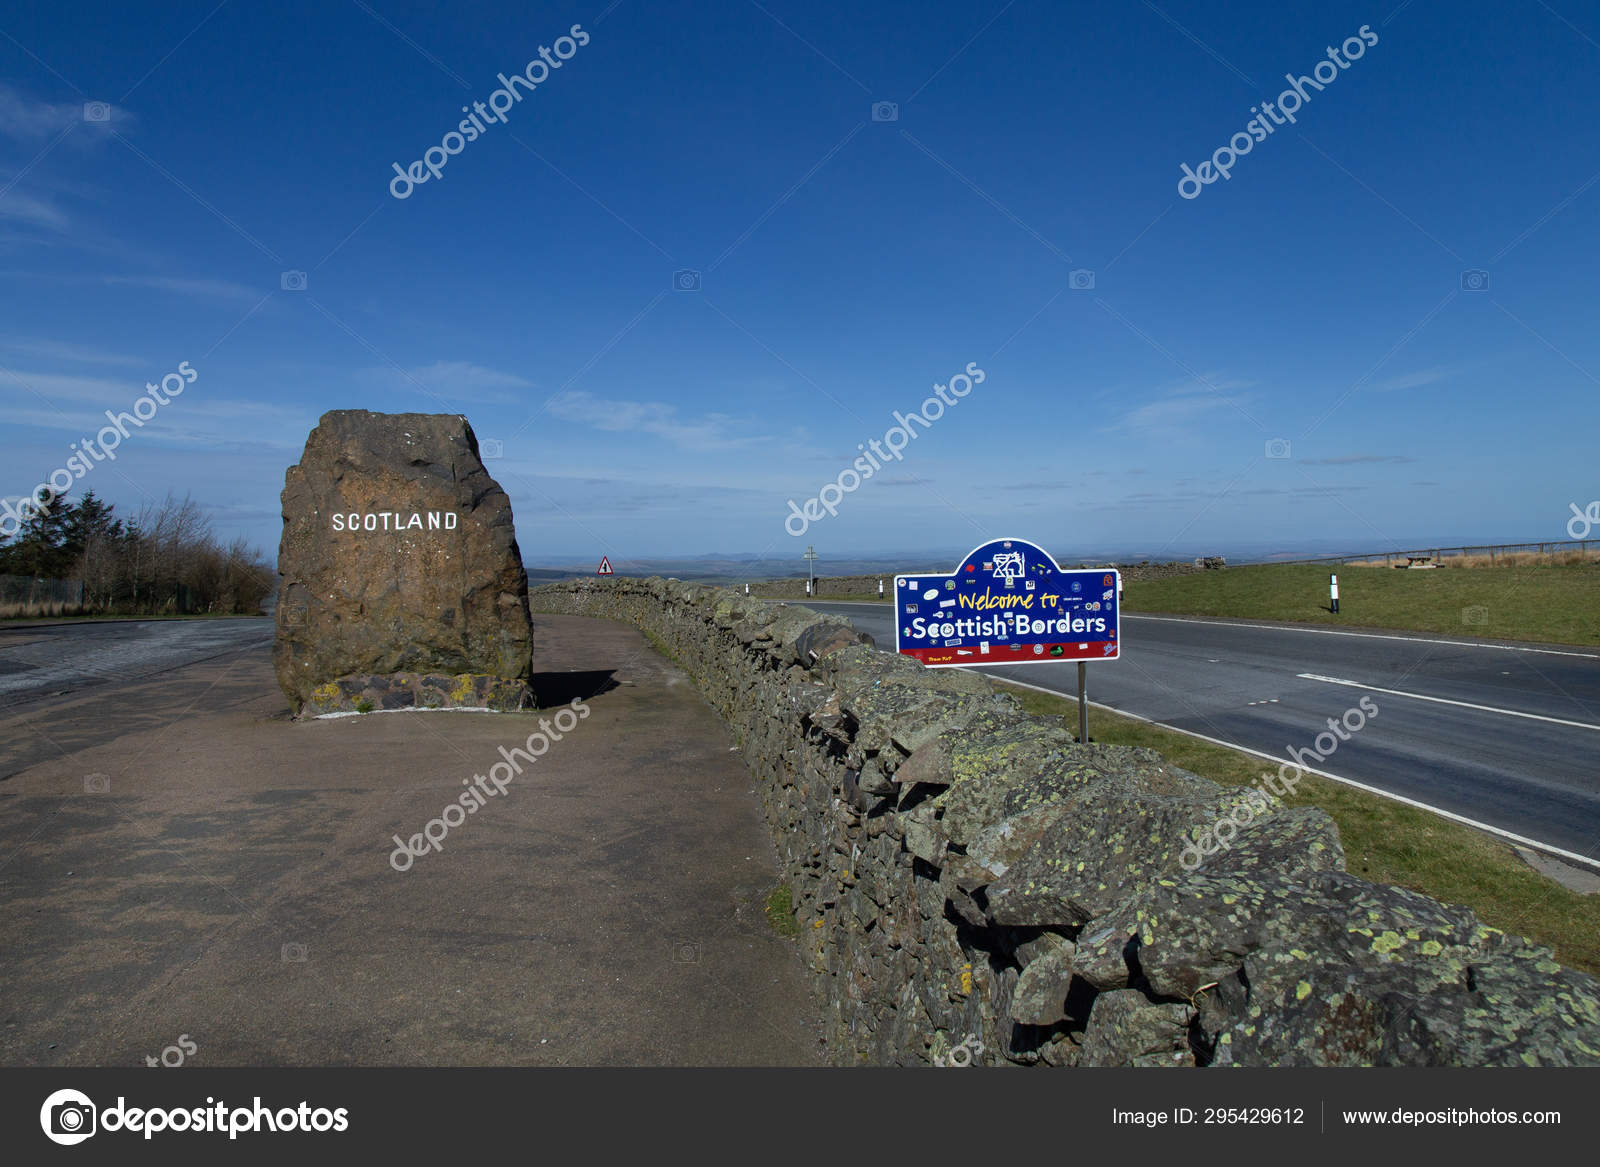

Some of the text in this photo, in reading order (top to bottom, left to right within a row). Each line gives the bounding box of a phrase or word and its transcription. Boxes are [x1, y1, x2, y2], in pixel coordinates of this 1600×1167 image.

[332, 511, 457, 531] SCOTLAND
[959, 586, 1060, 611] Welcome to
[912, 612, 1106, 638] Scottish Borders
